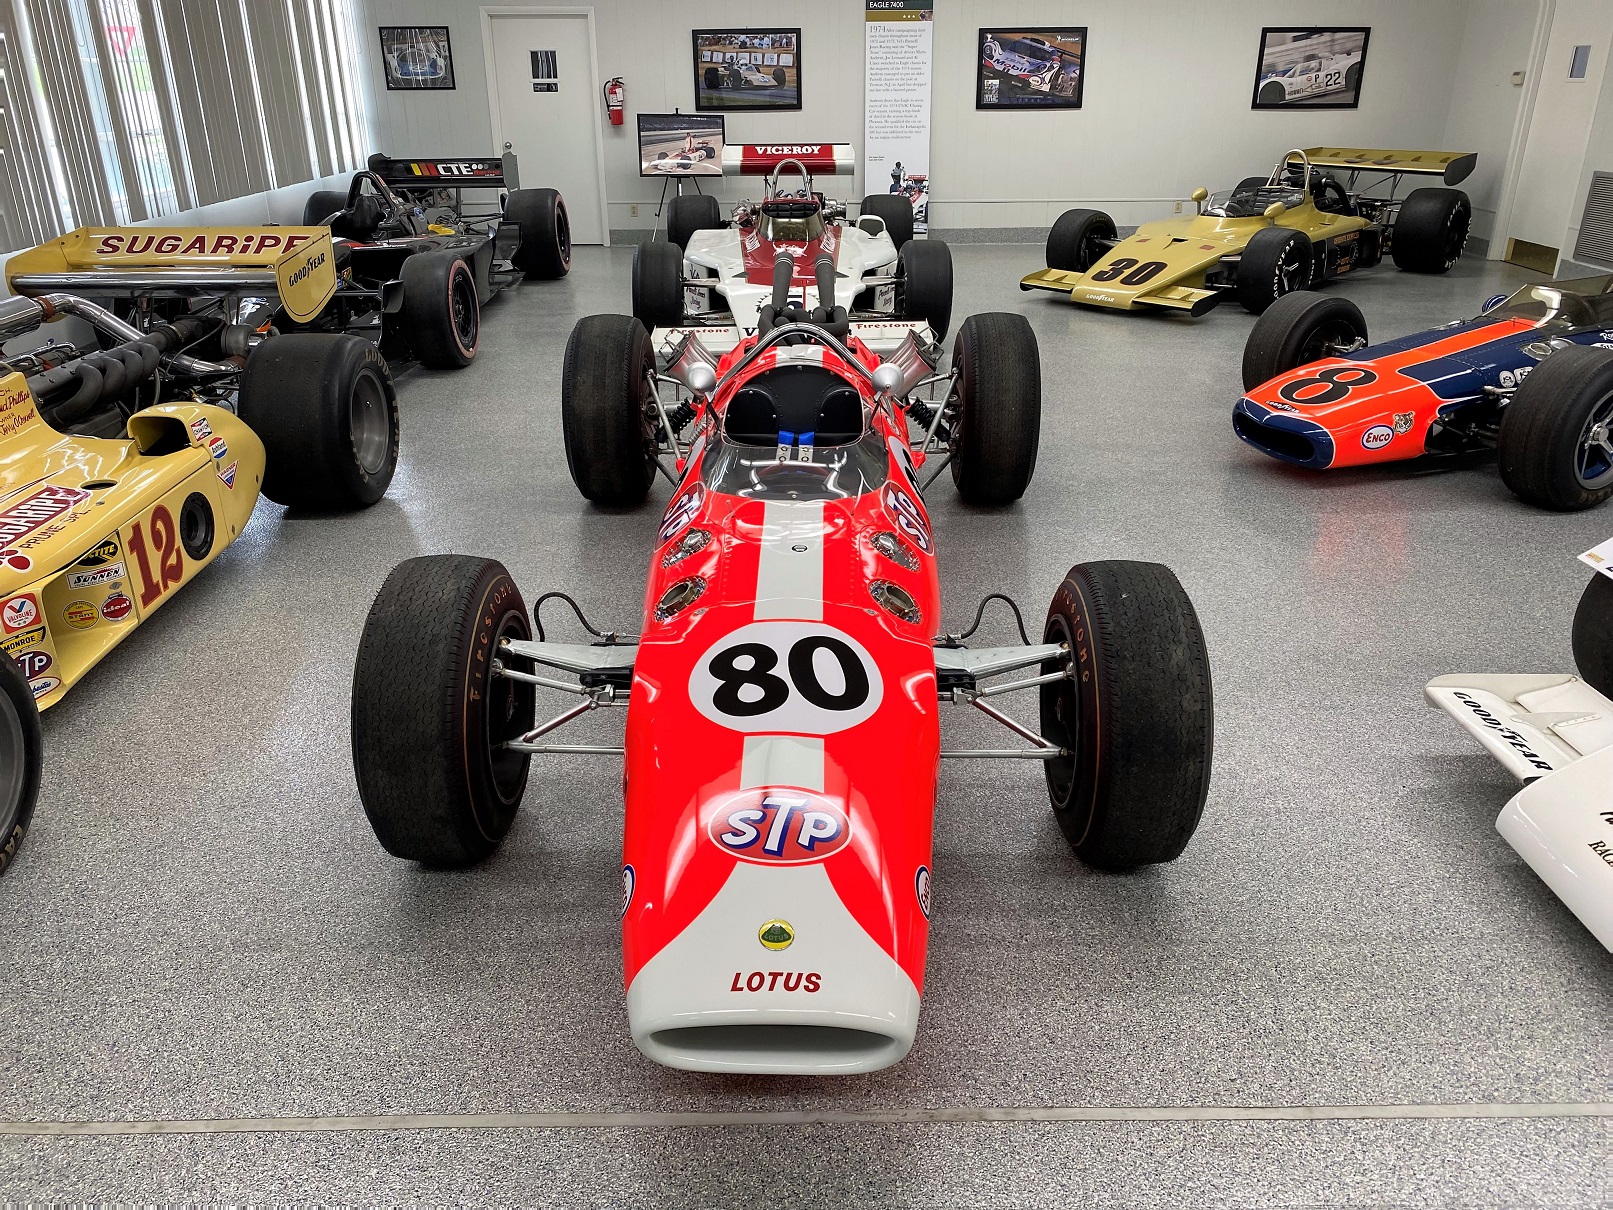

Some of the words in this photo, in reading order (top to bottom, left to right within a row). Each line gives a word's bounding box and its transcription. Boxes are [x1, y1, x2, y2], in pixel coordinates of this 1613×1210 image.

[1315, 74, 1320, 83] P
[1325, 71, 1341, 87] 22
[755, 145, 821, 155] VICEROY
[437, 164, 474, 175] CTE
[1090, 258, 1168, 286] 30
[668, 328, 730, 336] Frestone
[1277, 366, 1379, 406] 8
[1365, 432, 1390, 444] ENCO
[18, 524, 66, 549] PRUNE
[84, 544, 115, 558] CTITE
[128, 504, 184, 609] 12
[74, 568, 120, 584] SUNNEN
[103, 600, 130, 613] ideal
[7, 608, 33, 623] VALVOLINE
[4, 634, 36, 651] MONROE
[18, 652, 48, 677] TP
[708, 635, 870, 717] 80
[719, 796, 841, 858] STP
[764, 933, 789, 941] LOTUS
[730, 971, 822, 993] LOTUS
